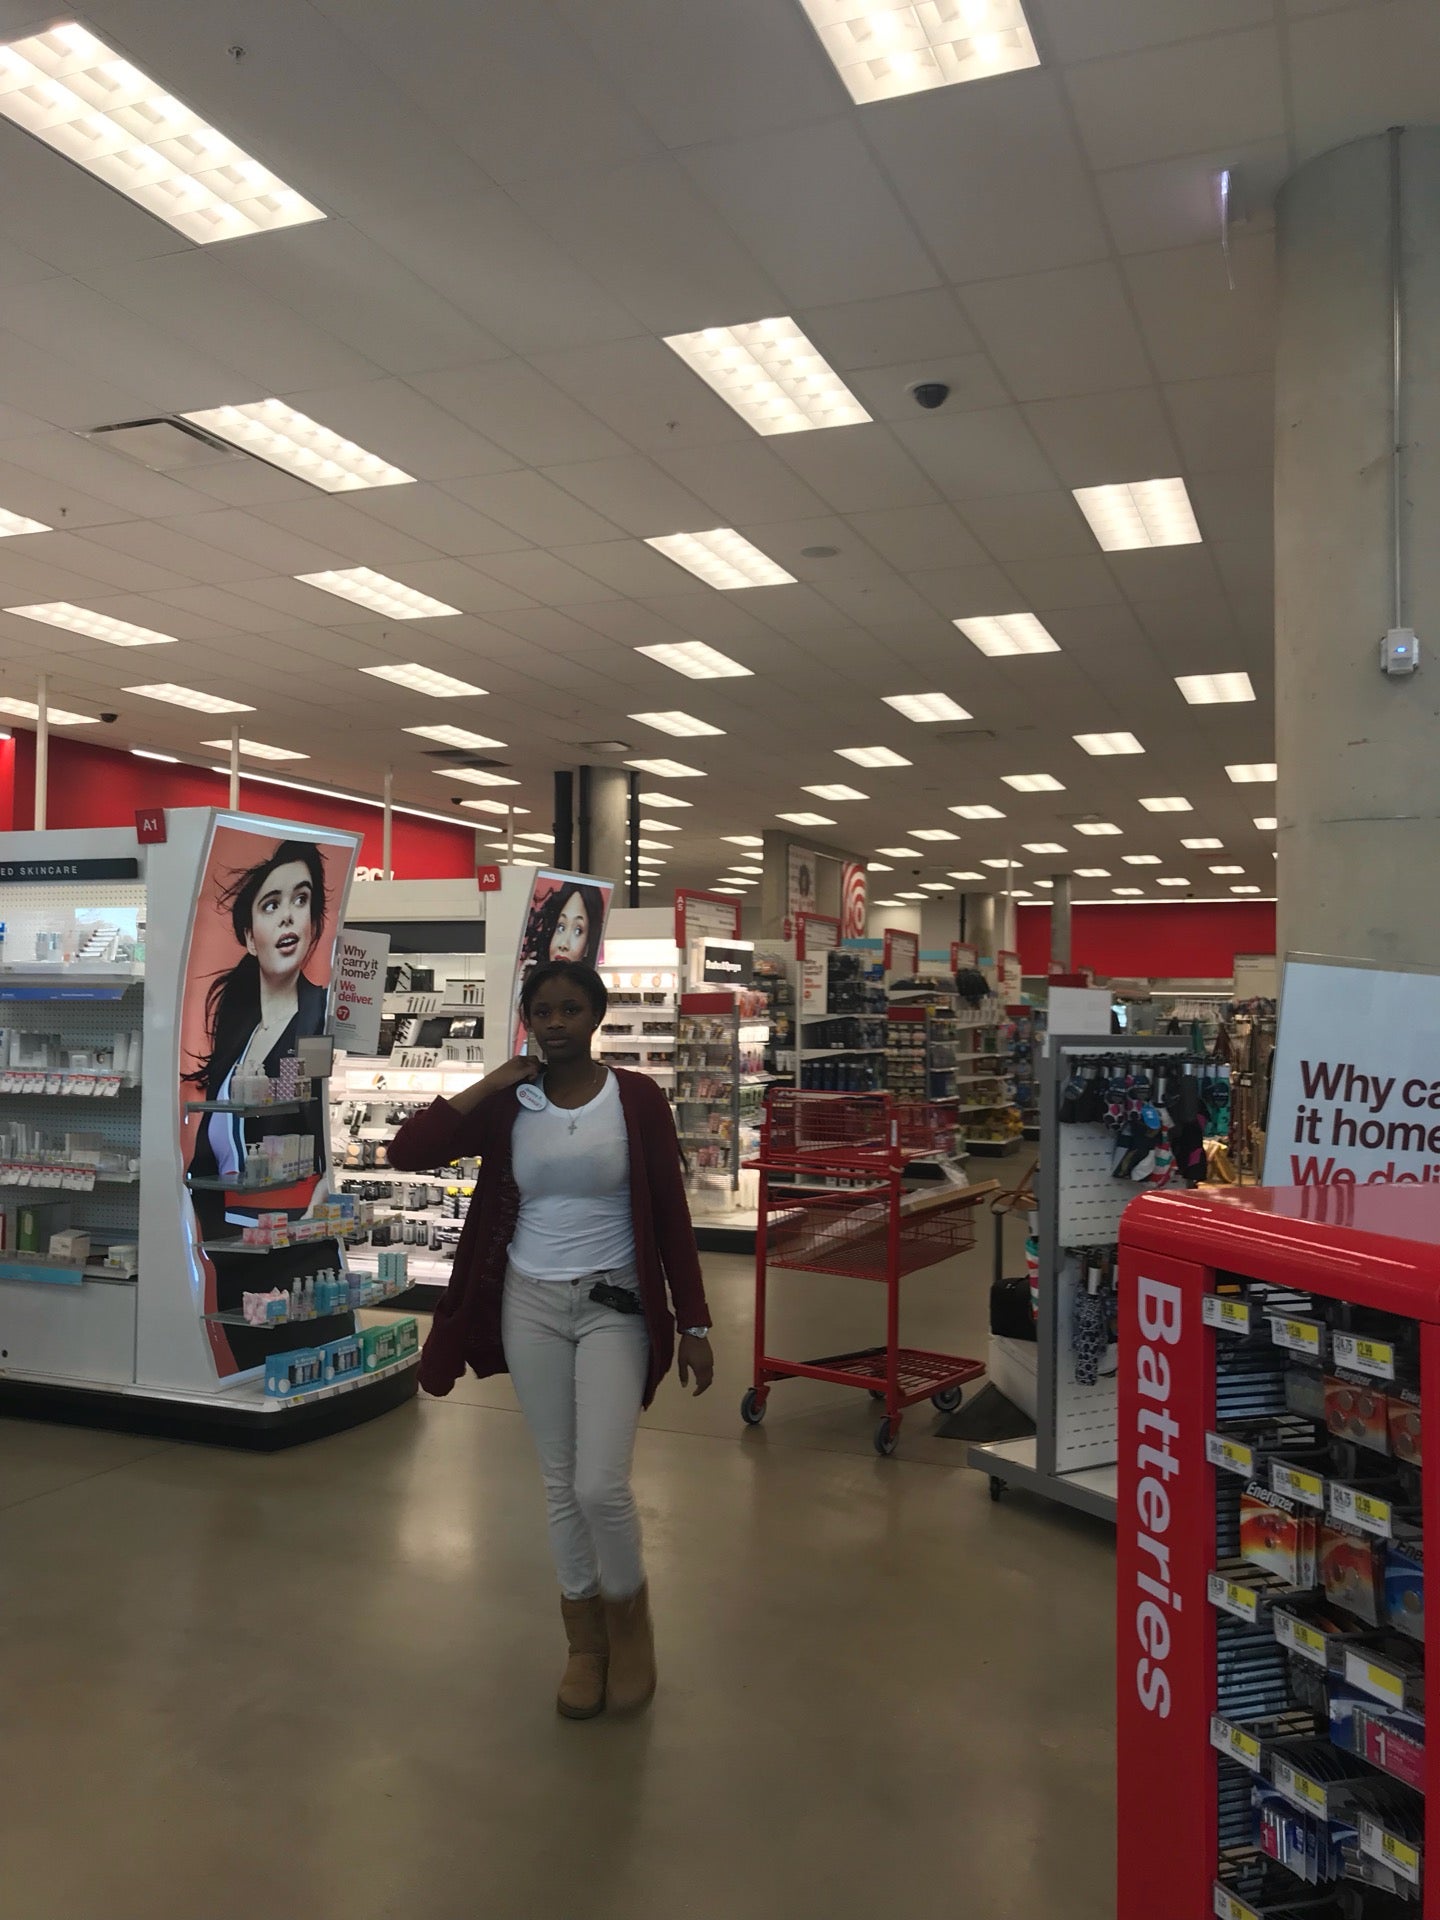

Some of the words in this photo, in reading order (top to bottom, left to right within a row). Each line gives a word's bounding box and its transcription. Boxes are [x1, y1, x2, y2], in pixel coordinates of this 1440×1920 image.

[143, 819, 157, 831] A1
[20, 865, 78, 875] SKINCARE
[483, 873, 495, 883] A3
[343, 945, 367, 959] Why
[342, 957, 371, 970] carry
[371, 959, 378, 970] it
[341, 966, 376, 980] home?
[340, 981, 356, 991] We
[338, 991, 373, 1005] deliver.
[1300, 1060, 1396, 1113] Why
[1294, 1104, 1322, 1145] it
[1137, 1276, 1182, 1719] Batteries
[1247, 1481, 1295, 1514] Energizer
